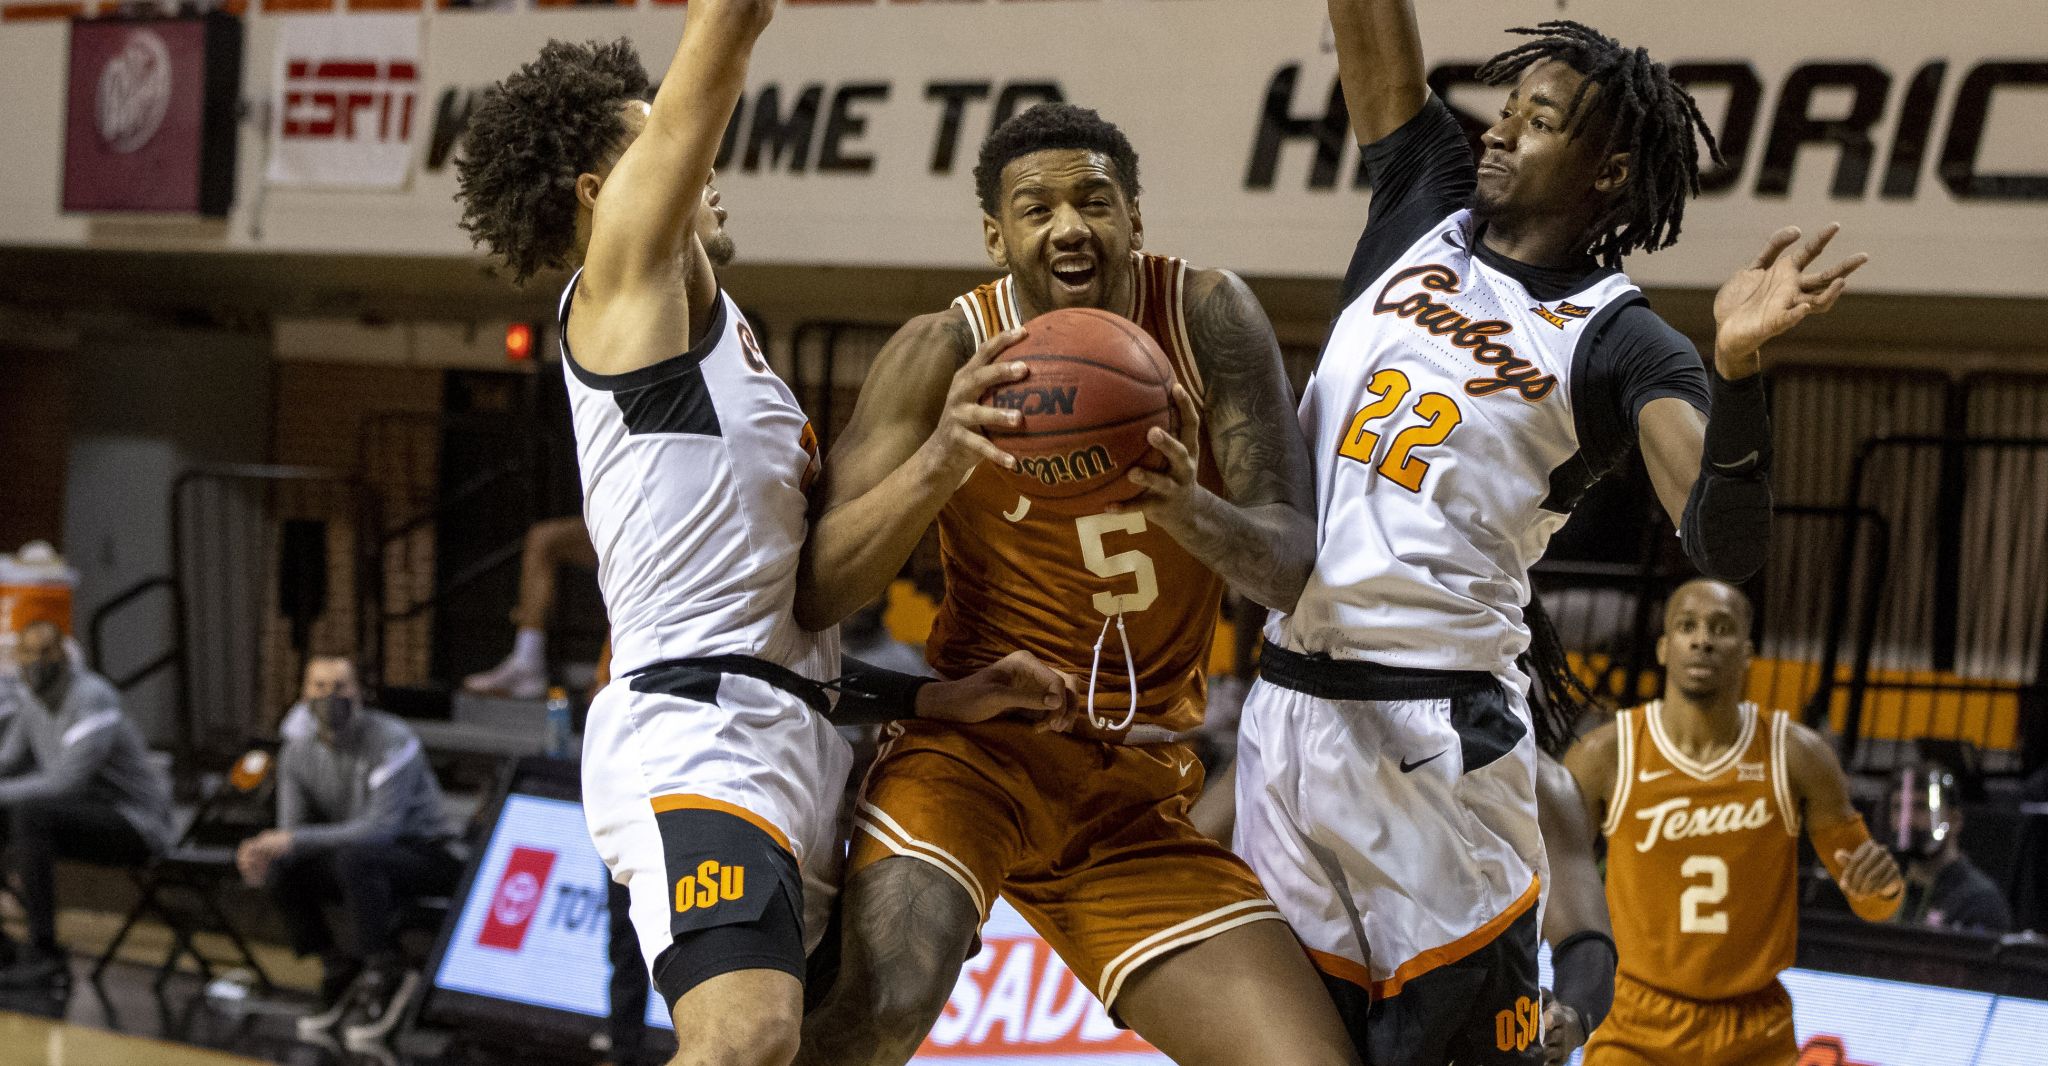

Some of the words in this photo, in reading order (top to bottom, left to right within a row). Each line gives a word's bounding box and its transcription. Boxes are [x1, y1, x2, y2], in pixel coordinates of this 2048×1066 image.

[284, 58, 418, 142] ESPN
[1372, 262, 1558, 403] Cowboys
[1337, 367, 1463, 494] 22
[1075, 510, 1160, 618] 5
[1634, 796, 1775, 853] Texas
[675, 859, 745, 914] OSU
[1679, 855, 1730, 934] 2
